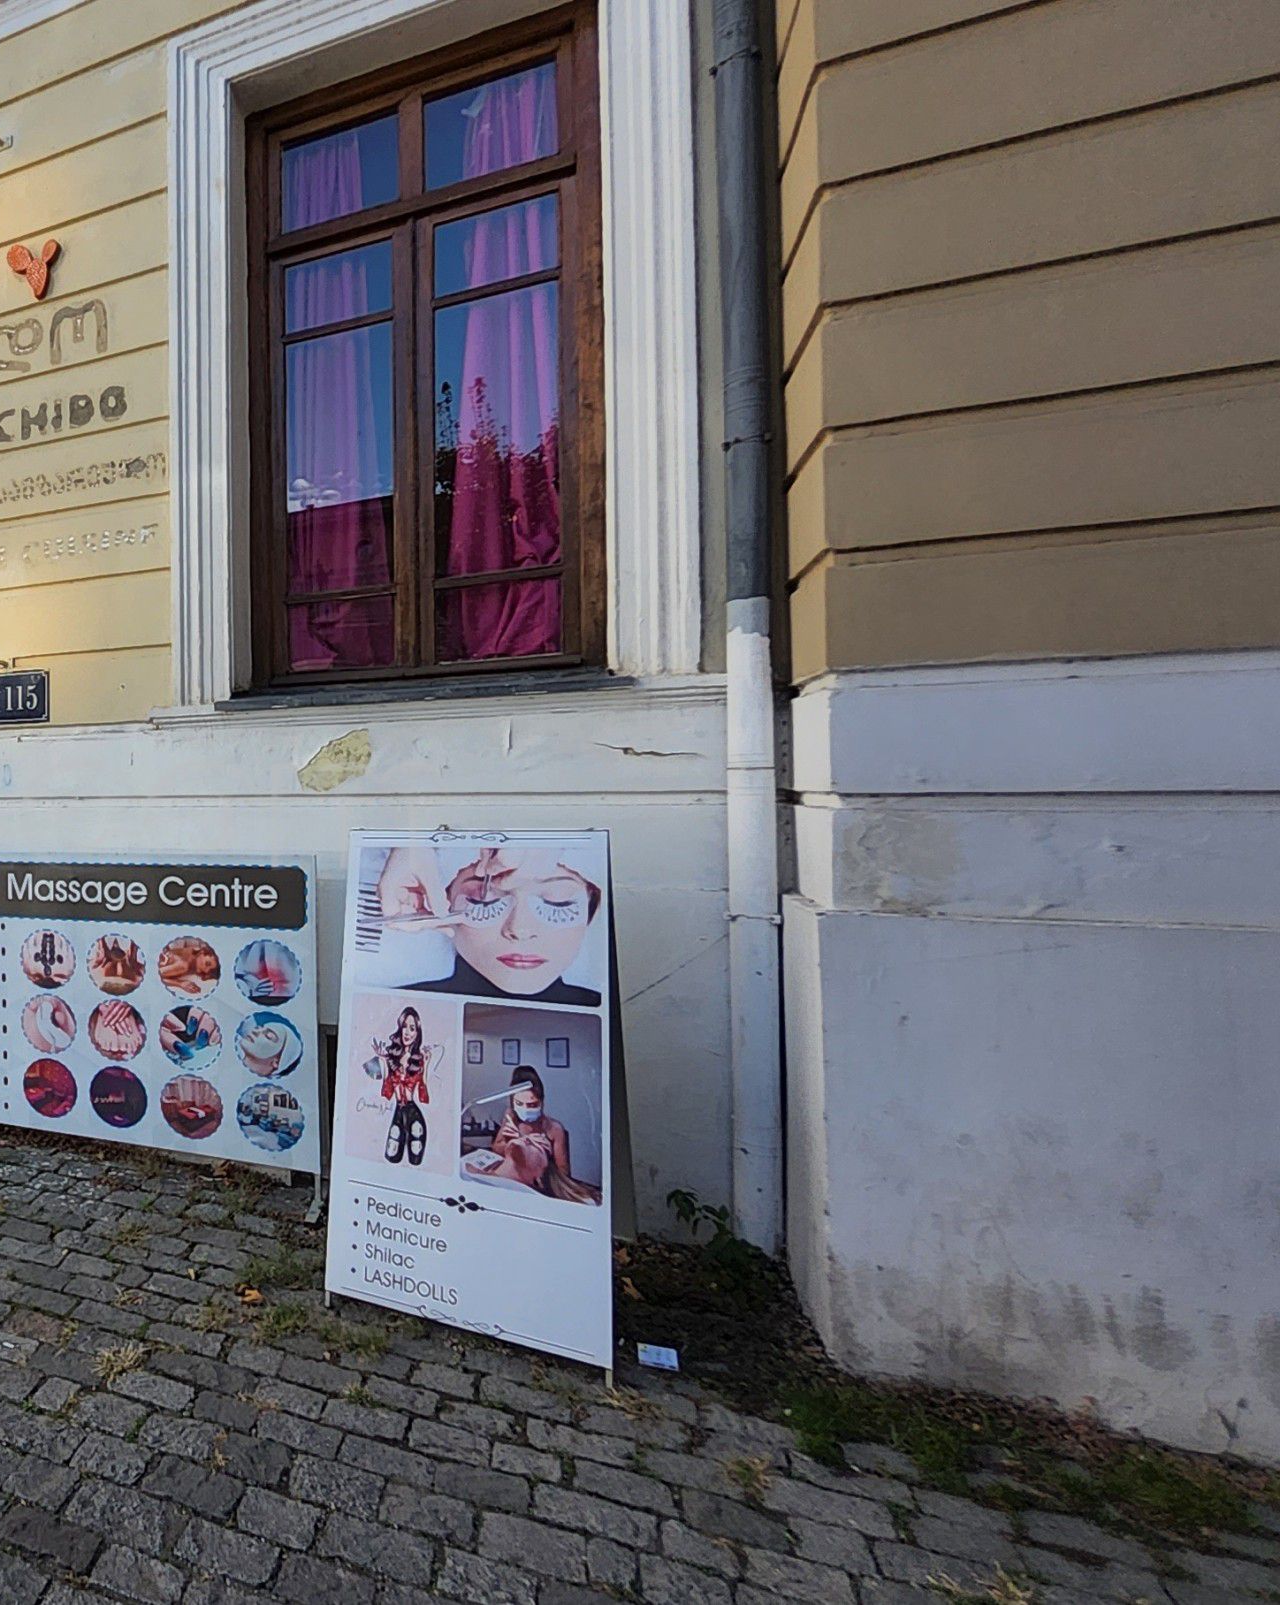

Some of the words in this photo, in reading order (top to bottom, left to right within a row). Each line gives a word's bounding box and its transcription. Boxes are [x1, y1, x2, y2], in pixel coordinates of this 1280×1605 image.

[5, 684, 38, 711] 115
[7, 872, 148, 911] Massage
[158, 876, 279, 910] Centre
[367, 1196, 442, 1227] Pedicure
[366, 1219, 447, 1253] Manicure
[365, 1243, 415, 1269] Shilac
[364, 1266, 458, 1305] LASHDOLLS
